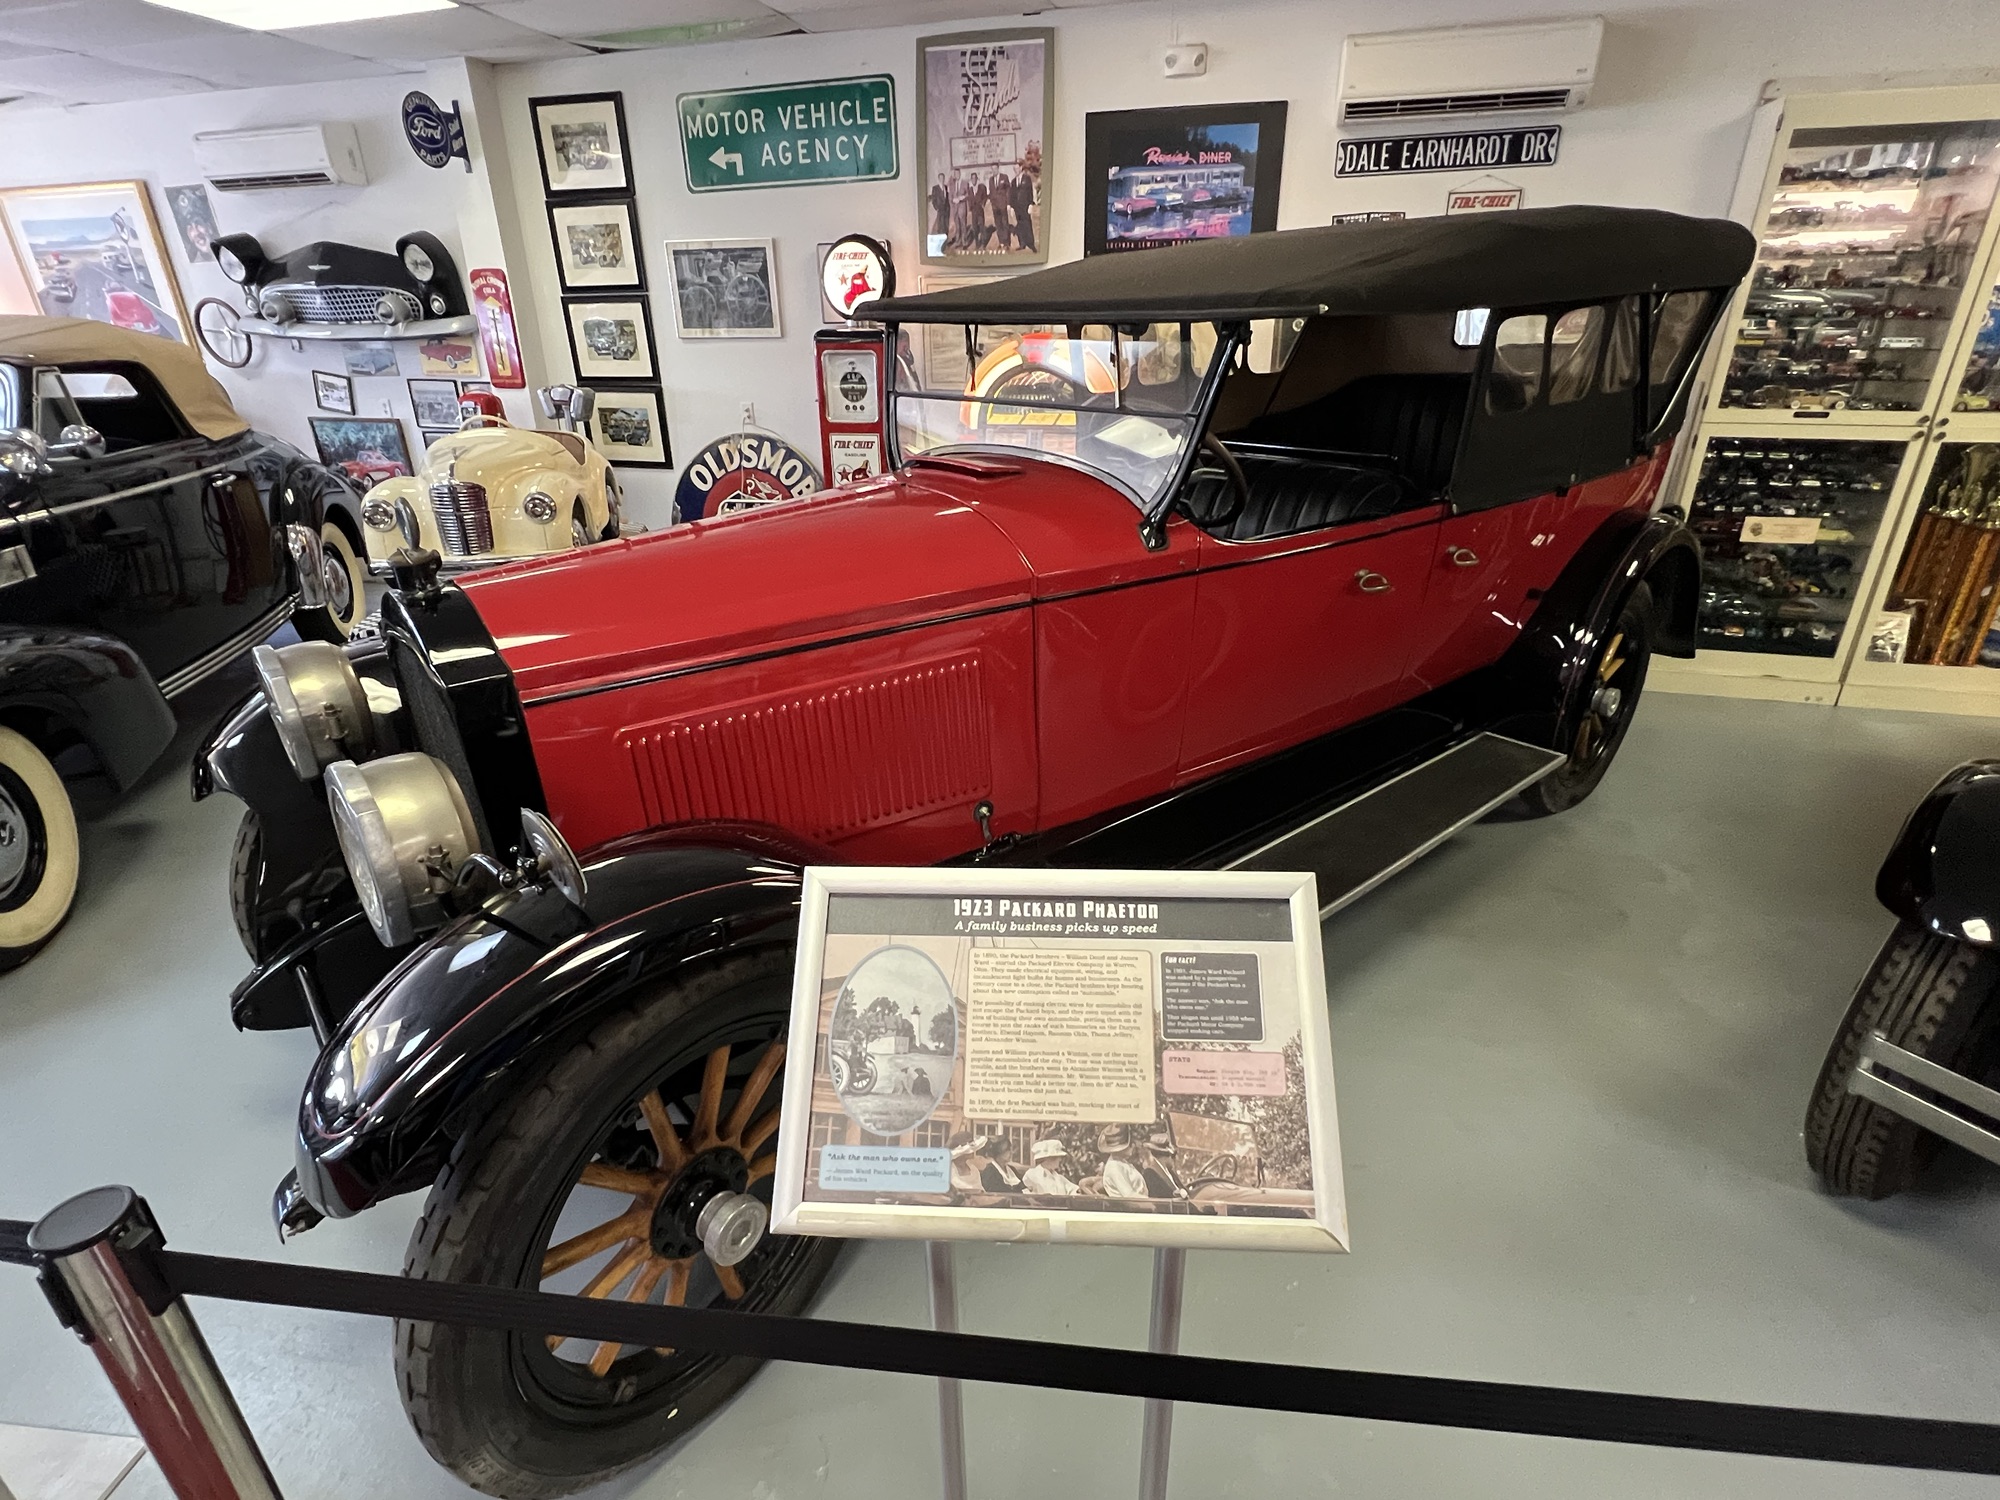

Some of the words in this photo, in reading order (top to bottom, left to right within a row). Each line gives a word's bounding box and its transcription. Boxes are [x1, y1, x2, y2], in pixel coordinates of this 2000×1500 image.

[686, 107, 766, 139] MOTOR
[777, 97, 887, 131] VEHICLE
[411, 116, 442, 140] Ford
[761, 134, 869, 167] AGENCY
[1199, 151, 1232, 164] DINER
[1344, 142, 1393, 173] DALE
[1401, 134, 1513, 169] EARNHARDT
[1521, 132, 1549, 162] DR
[1451, 194, 1516, 209] FIRE-CHIEF
[832, 252, 870, 260] FIRE-CHIEF
[834, 440, 876, 450] FIRE-CHIEF
[954, 898, 993, 917] 1923
[1000, 899, 1076, 918] PACKARD
[1083, 901, 1159, 920] PHAETON
[954, 920, 964, 930] A
[966, 920, 1008, 932] family
[1010, 921, 1062, 932] business
[1064, 922, 1100, 934] picks
[1102, 924, 1119, 935] up
[1122, 924, 1158, 935] speed
